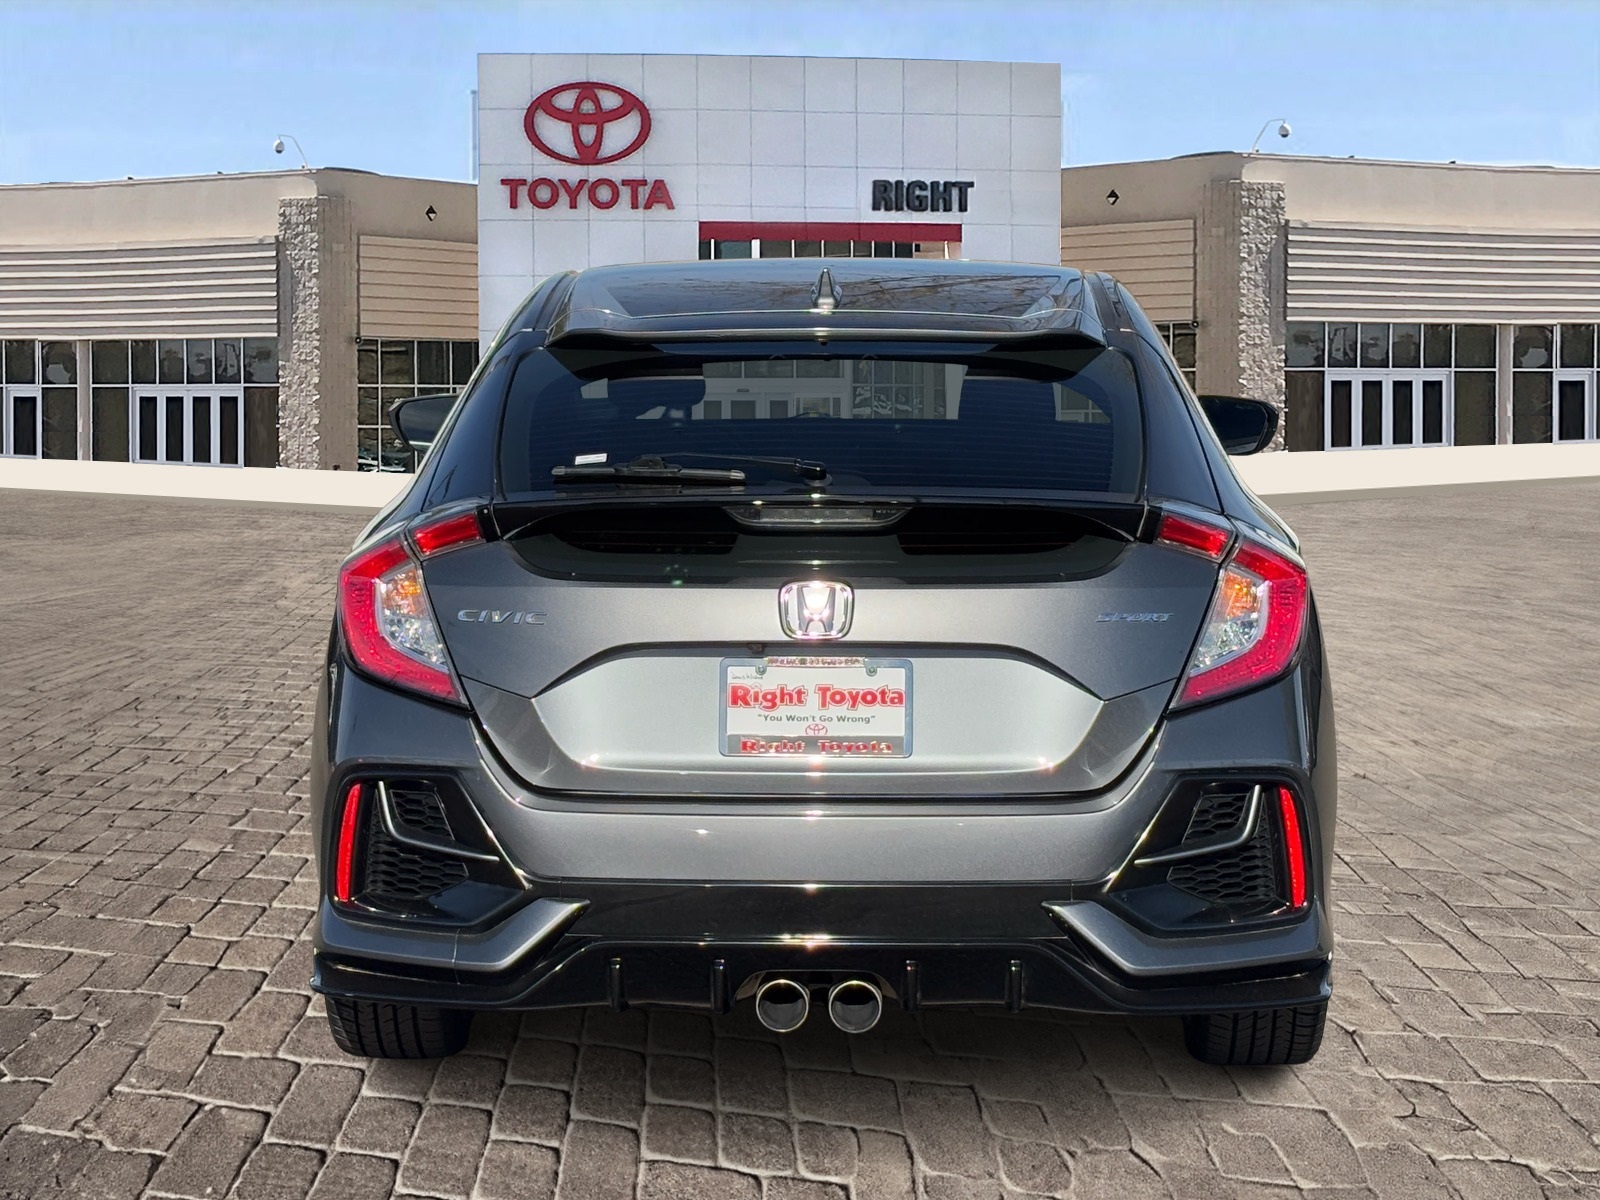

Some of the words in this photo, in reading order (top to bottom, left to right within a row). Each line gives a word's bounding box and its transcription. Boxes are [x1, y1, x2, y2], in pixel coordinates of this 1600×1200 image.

[500, 177, 675, 210] TOYOTA
[872, 179, 975, 212] RIGHT
[457, 609, 549, 625] CIVIC
[728, 682, 808, 711] Right
[815, 684, 906, 711] Toyota
[785, 714, 816, 723] Won't
[819, 714, 834, 723] Go
[740, 738, 806, 754] Right
[817, 739, 893, 755] Toyota
